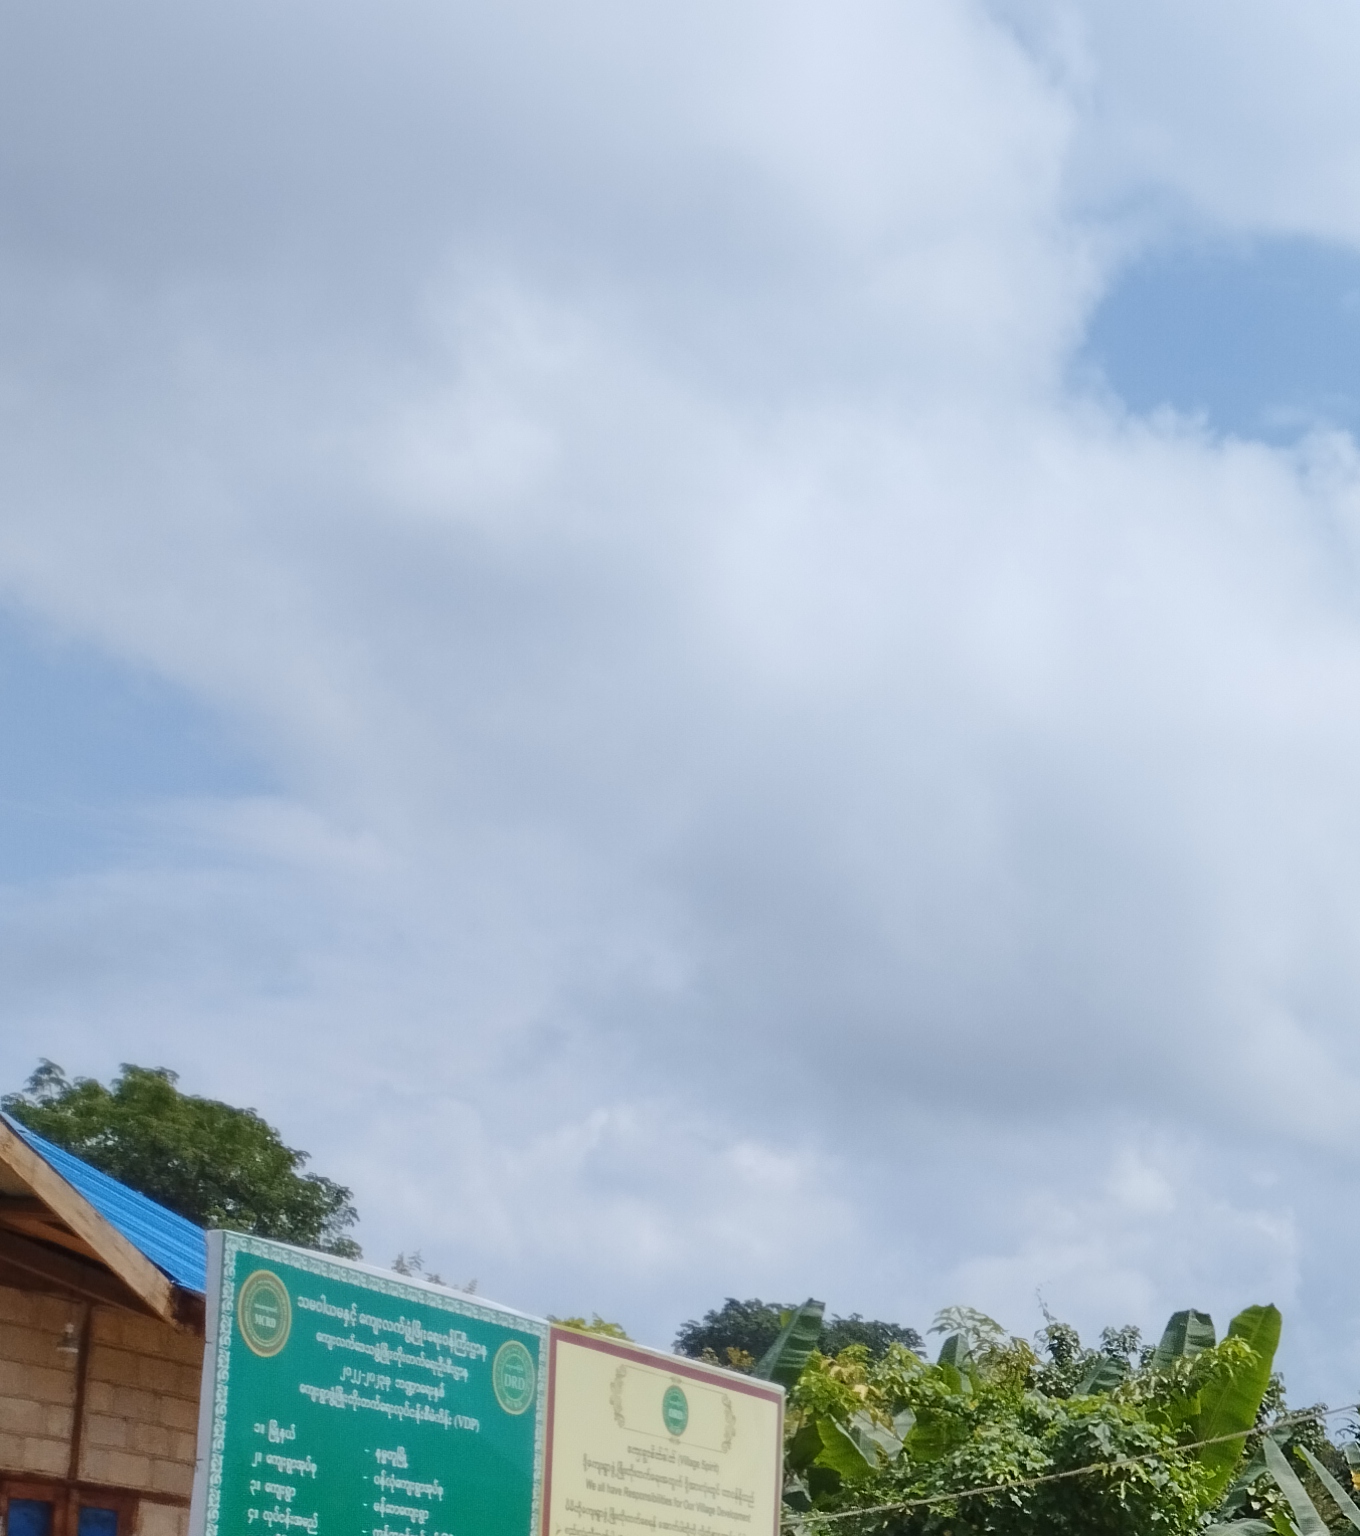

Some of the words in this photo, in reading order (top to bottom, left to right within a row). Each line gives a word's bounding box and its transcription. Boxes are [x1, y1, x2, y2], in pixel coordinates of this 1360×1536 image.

[504, 1373, 525, 1390] DRD
[454, 1414, 479, 1433] (VDP)
[264, 1482, 296, 1502] ကျေးရွာ
